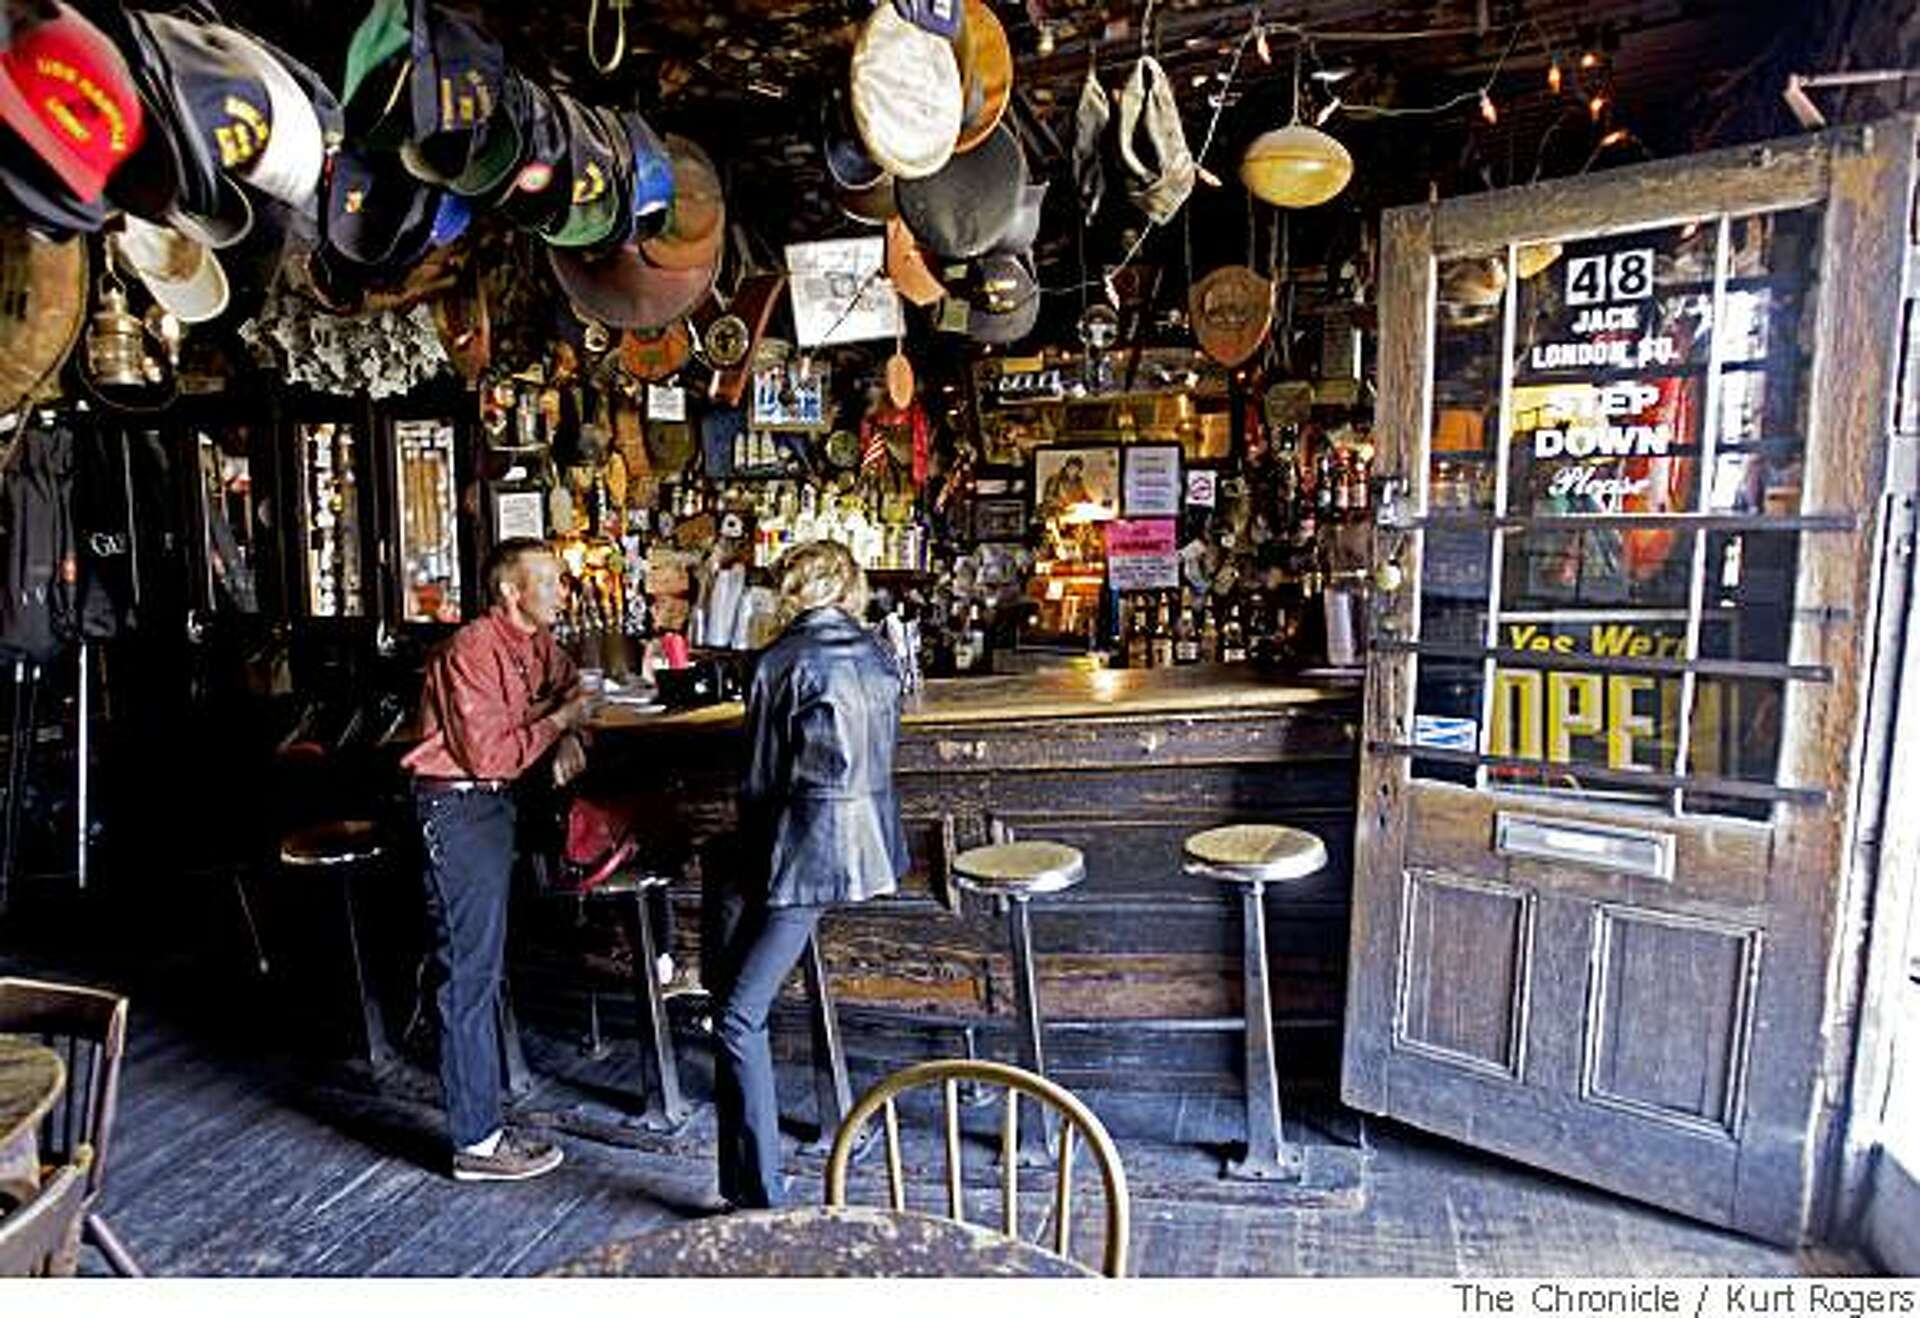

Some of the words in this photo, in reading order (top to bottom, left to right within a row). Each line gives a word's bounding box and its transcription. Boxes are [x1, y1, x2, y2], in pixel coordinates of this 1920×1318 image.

[1570, 254, 1648, 299] 48
[1571, 306, 1639, 334] JACK
[1532, 340, 1629, 369] LONDON
[1546, 386, 1660, 417] STEP
[1535, 424, 1672, 457] DOWN
[1509, 624, 1576, 653] Yes
